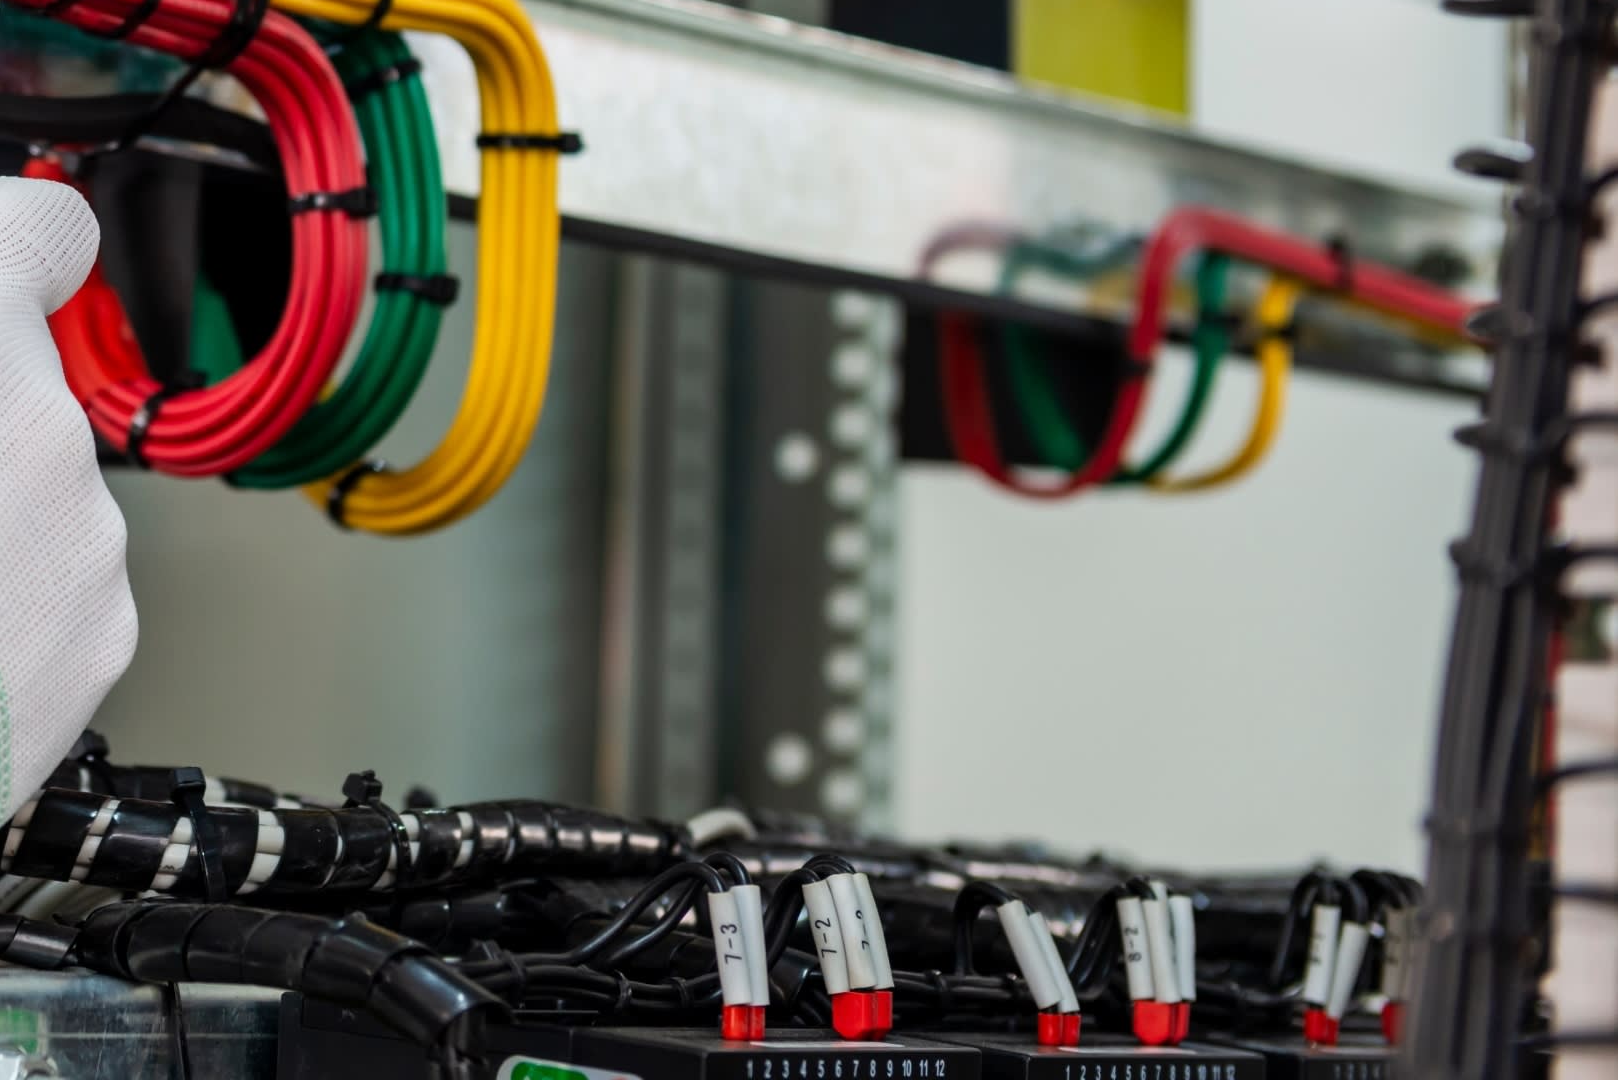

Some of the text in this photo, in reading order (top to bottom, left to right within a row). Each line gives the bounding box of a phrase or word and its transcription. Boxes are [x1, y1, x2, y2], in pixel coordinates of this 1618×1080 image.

[720, 922, 743, 965] 7-3
[814, 917, 838, 959] 7-2
[746, 1059, 945, 1079] 1 2 3 4 5 6 7 8 9 10 11 12
[1065, 1064, 1070, 1080] 1
[1081, 1064, 1087, 1080] 2
[1095, 1064, 1102, 1080] 3
[1110, 1064, 1117, 1080] 4
[1125, 1064, 1132, 1080] 5
[1140, 1064, 1146, 1080] 6
[1155, 1064, 1162, 1080] 7
